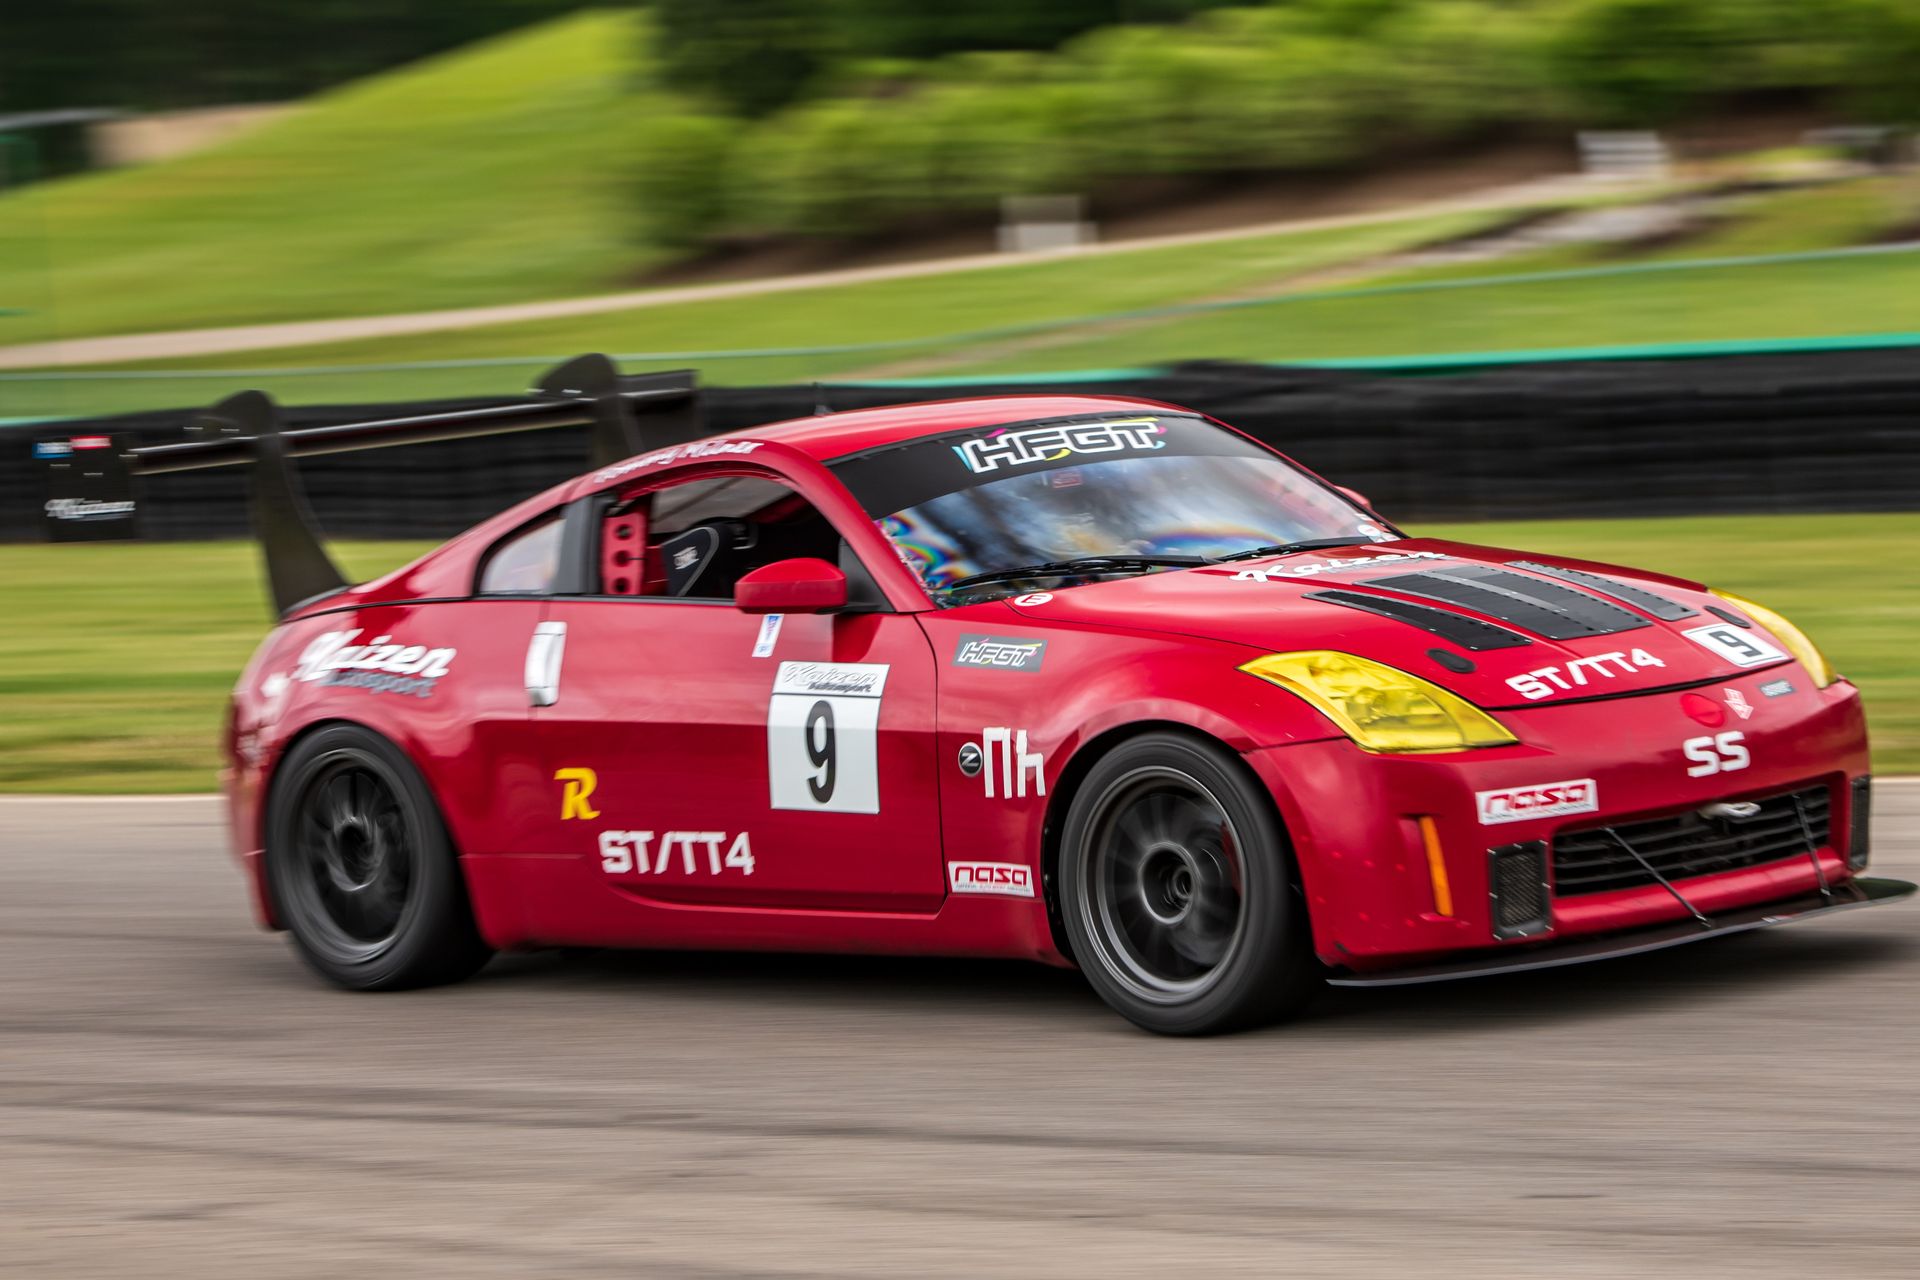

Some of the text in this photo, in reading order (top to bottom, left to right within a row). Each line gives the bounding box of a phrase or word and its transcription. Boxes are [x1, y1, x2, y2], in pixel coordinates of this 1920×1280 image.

[961, 422, 1159, 474] HFGT
[1229, 551, 1445, 583] Kaizen
[289, 628, 457, 682] Kaizen
[957, 641, 1037, 667] HFGT
[1708, 630, 1763, 658] 9
[782, 663, 880, 687] Kaizen
[1504, 648, 1667, 700] ST/TT4
[806, 700, 836, 803] 9
[1682, 730, 1750, 778] SS
[554, 767, 601, 820] R
[598, 830, 756, 876] ST/TT4
